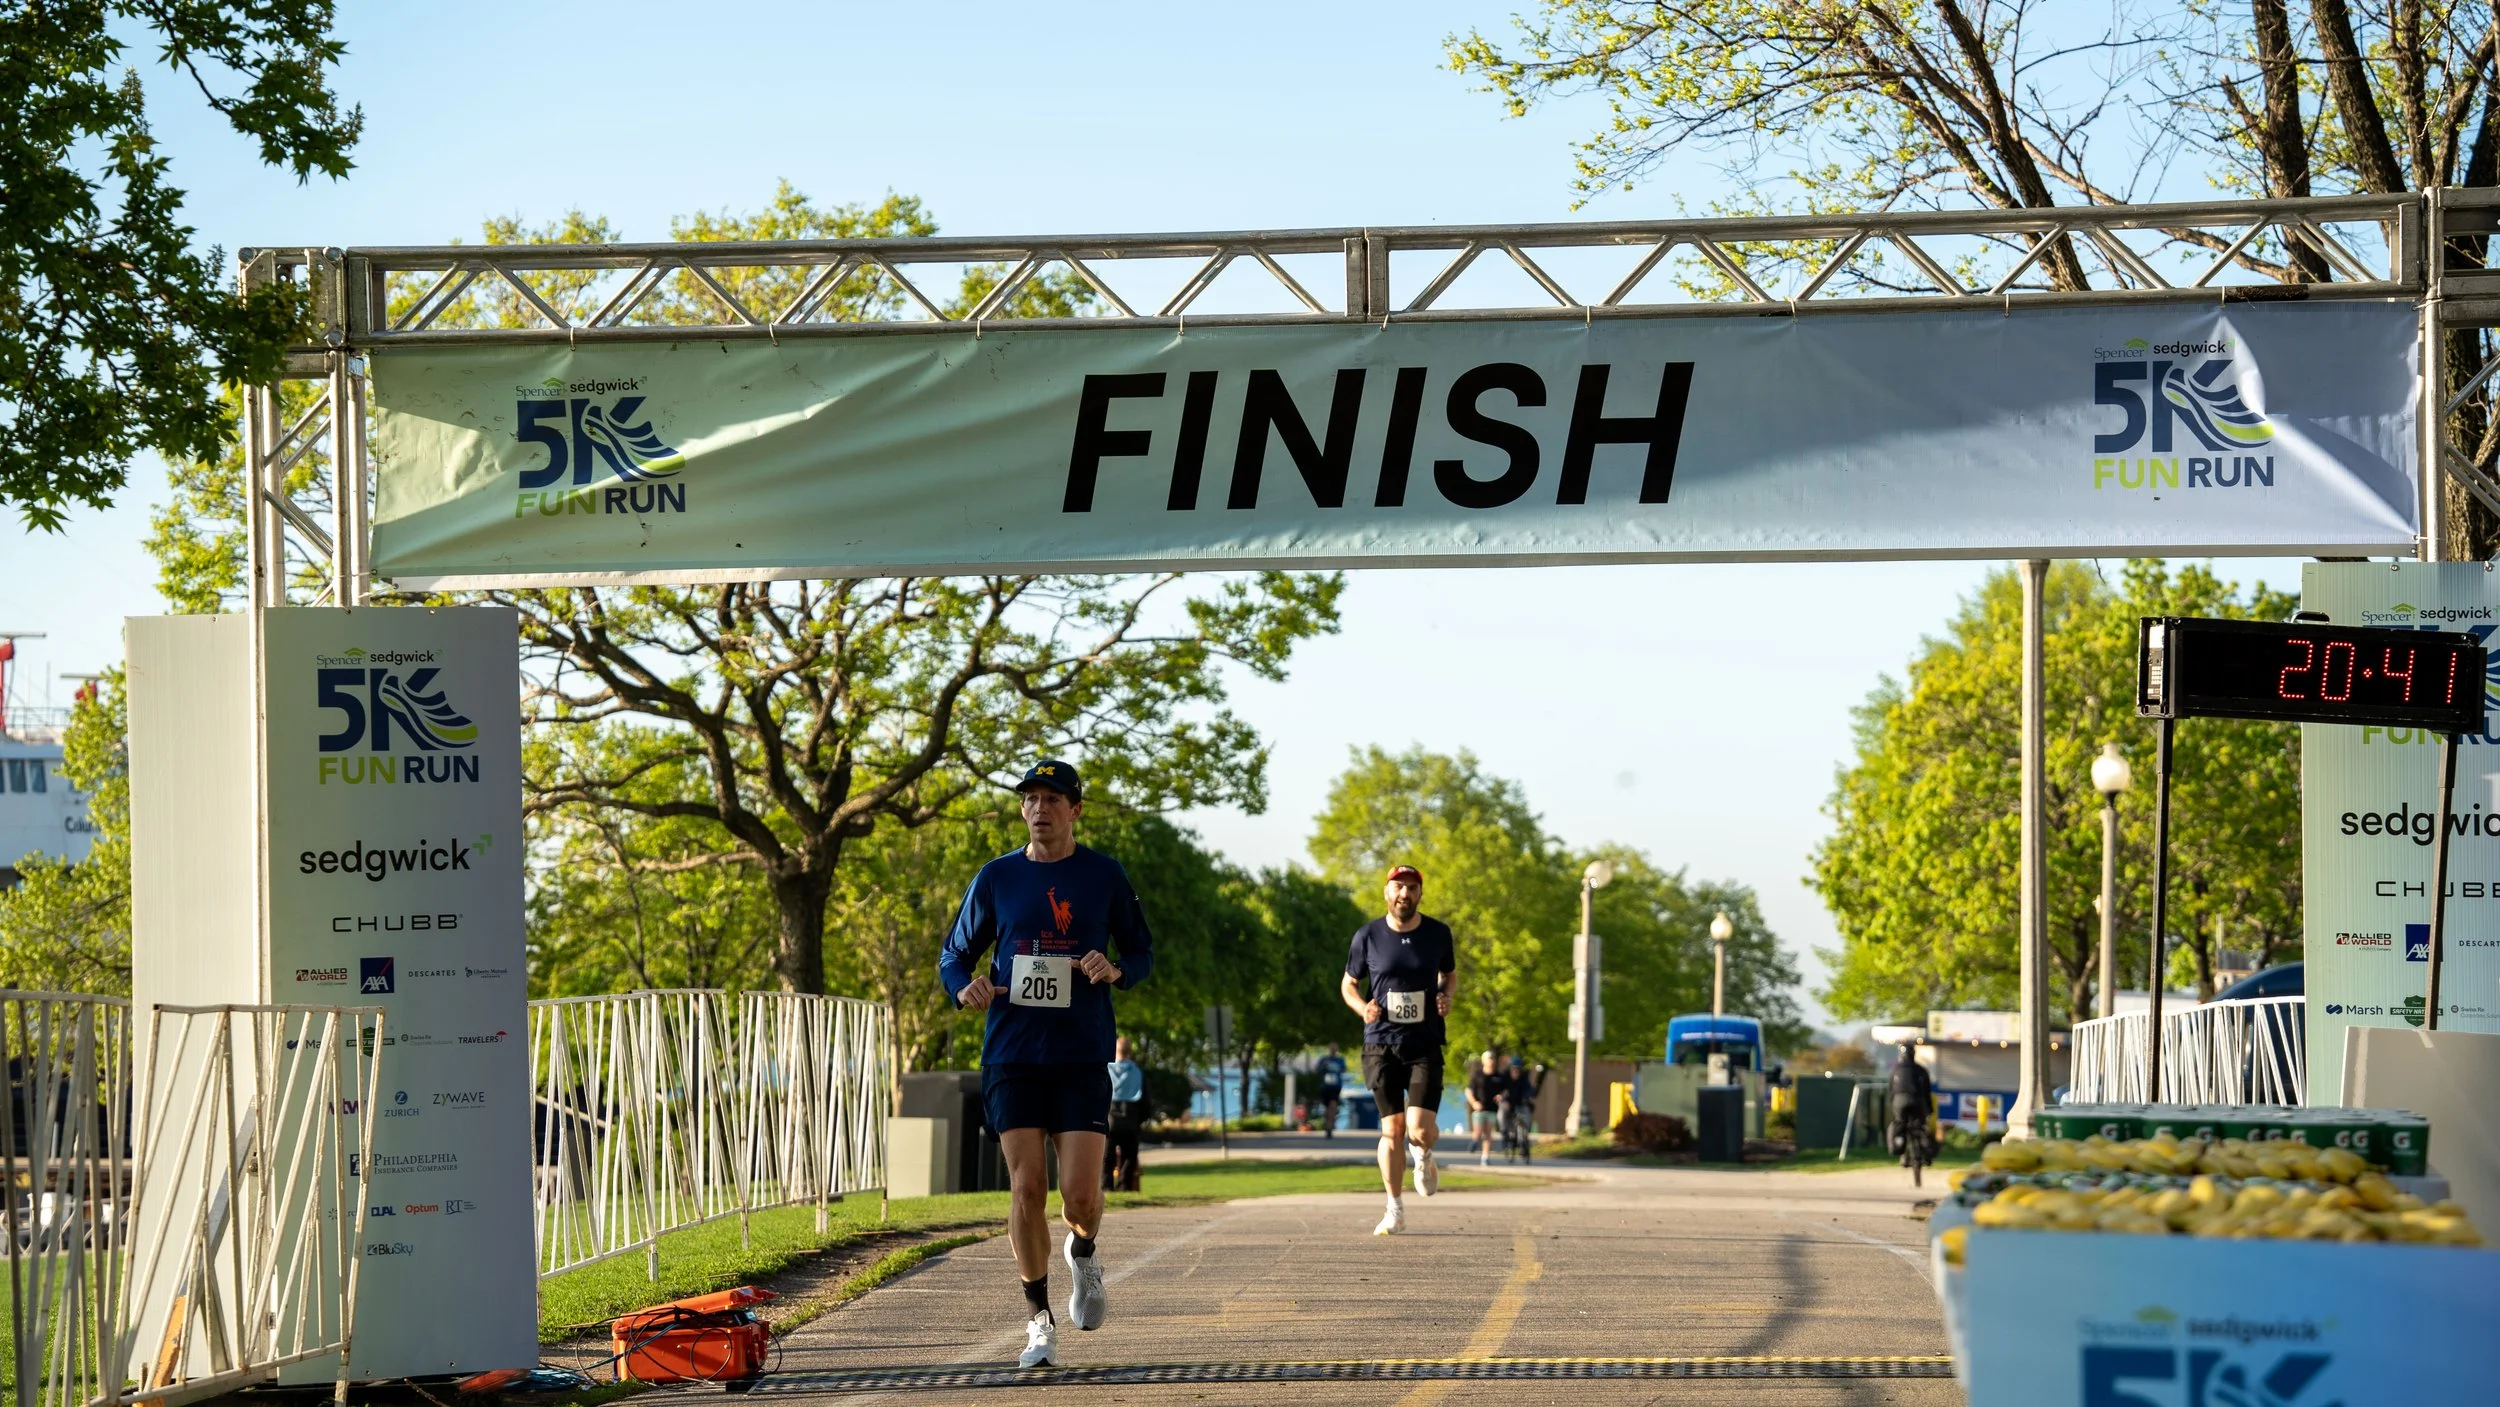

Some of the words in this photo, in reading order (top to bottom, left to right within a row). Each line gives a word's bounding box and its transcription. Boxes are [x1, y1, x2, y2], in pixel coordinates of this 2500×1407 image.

[2094, 347, 2144, 361] Spencer
[2153, 340, 2226, 357] sedgwick
[515, 384, 562, 399] Spencer
[569, 378, 639, 395] sedgwick
[2094, 360, 2274, 453] 5K
[517, 396, 686, 489] 5K
[1062, 361, 1696, 513] FINISH
[2094, 458, 2179, 489] FUN
[2188, 456, 2275, 488] RUN
[515, 488, 597, 518] FUN
[604, 483, 686, 514] RUN
[2361, 610, 2411, 624] Spencer
[2420, 606, 2492, 622] sedgwick
[316, 655, 363, 668] Spencer
[370, 650, 435, 665] sedgwick
[317, 668, 479, 752] 5K
[319, 756, 396, 785] FUN
[404, 755, 479, 783] RUN
[1035, 766, 1056, 776] M
[299, 838, 471, 882] sedgwick
[332, 914, 458, 933] CHUBB
[408, 969, 456, 977] DESCARTES
[361, 976, 389, 991] AXA
[1021, 977, 1058, 1001] 205
[1395, 1005, 1418, 1019] 268
[2346, 1005, 2383, 1015] Marsh
[458, 1035, 499, 1045] TRAVELERS
[384, 1108, 420, 1118] ZURICH
[2393, 1132, 2411, 1148] G
[373, 1153, 458, 1167] PHILADELPHIA
[371, 1206, 396, 1217] DUAL
[405, 1204, 439, 1215] Optum
[378, 1242, 414, 1256] BluSky
